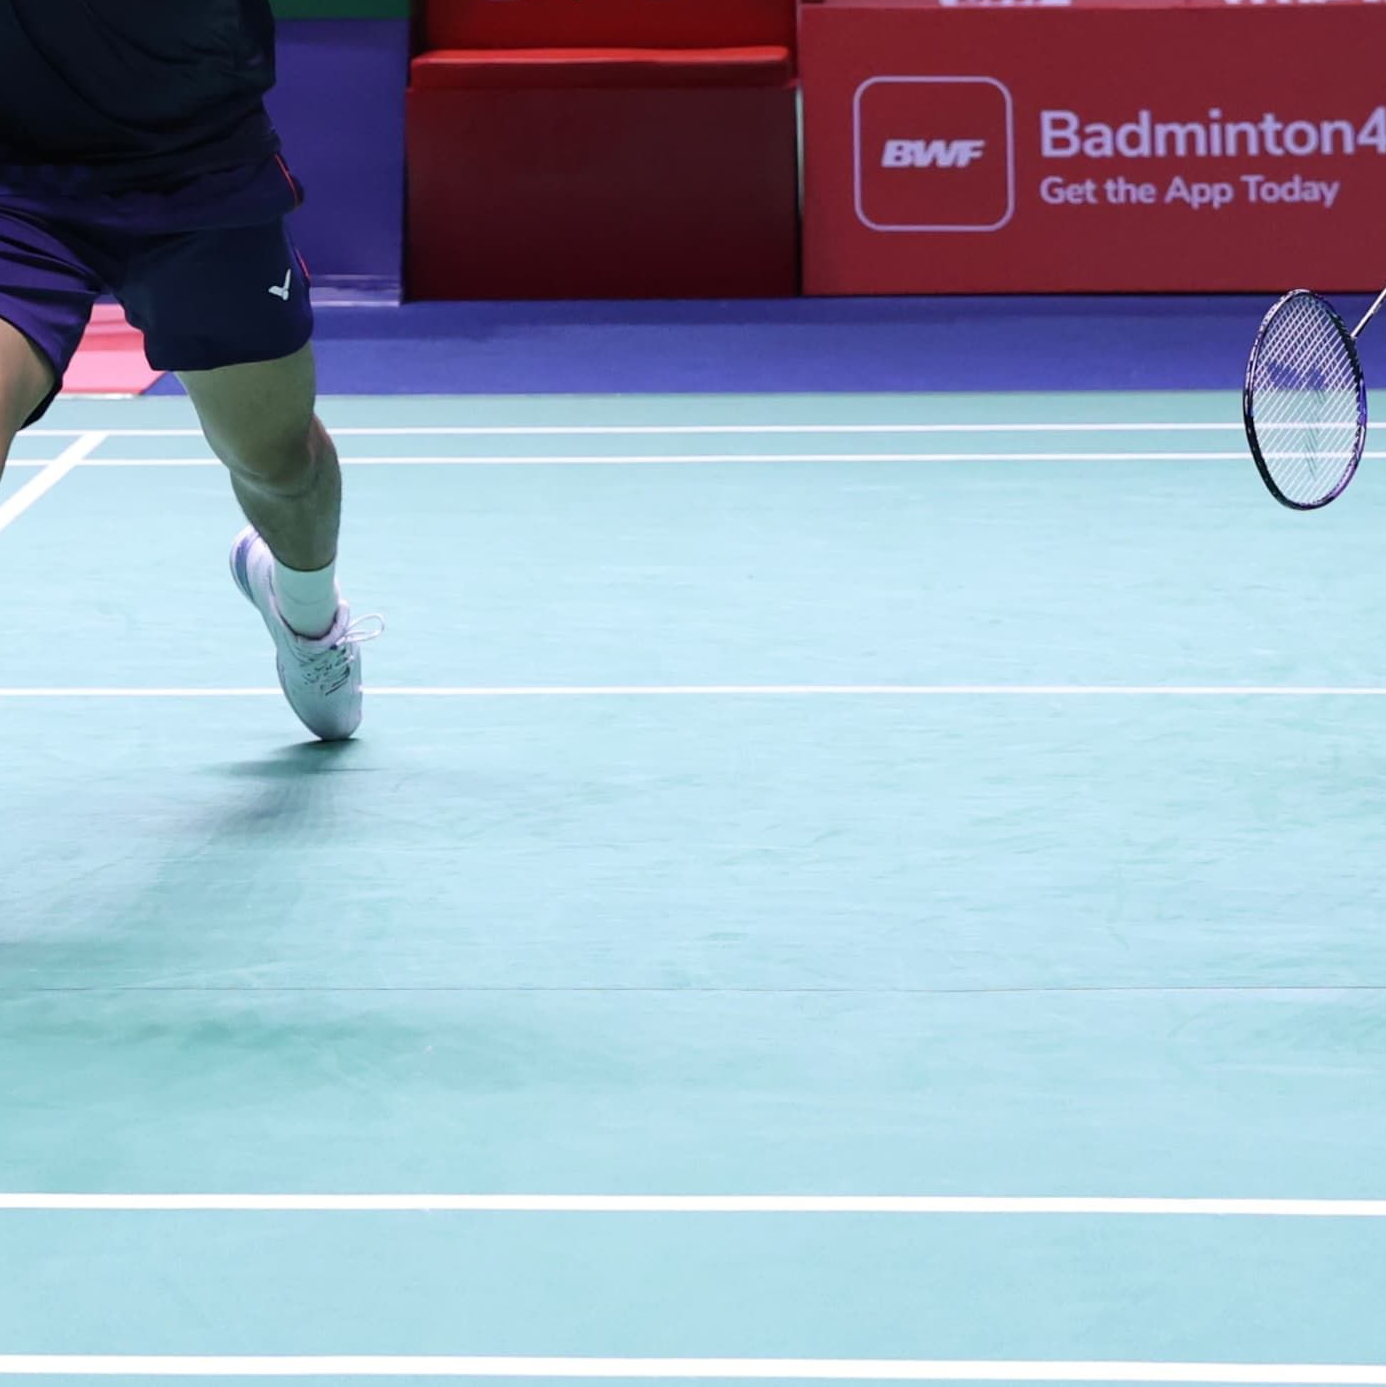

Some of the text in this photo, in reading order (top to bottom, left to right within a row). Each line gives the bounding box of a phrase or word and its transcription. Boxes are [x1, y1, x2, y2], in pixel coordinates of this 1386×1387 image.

[881, 139, 986, 168] BWF
[1040, 174, 1340, 210] Get the App Today
